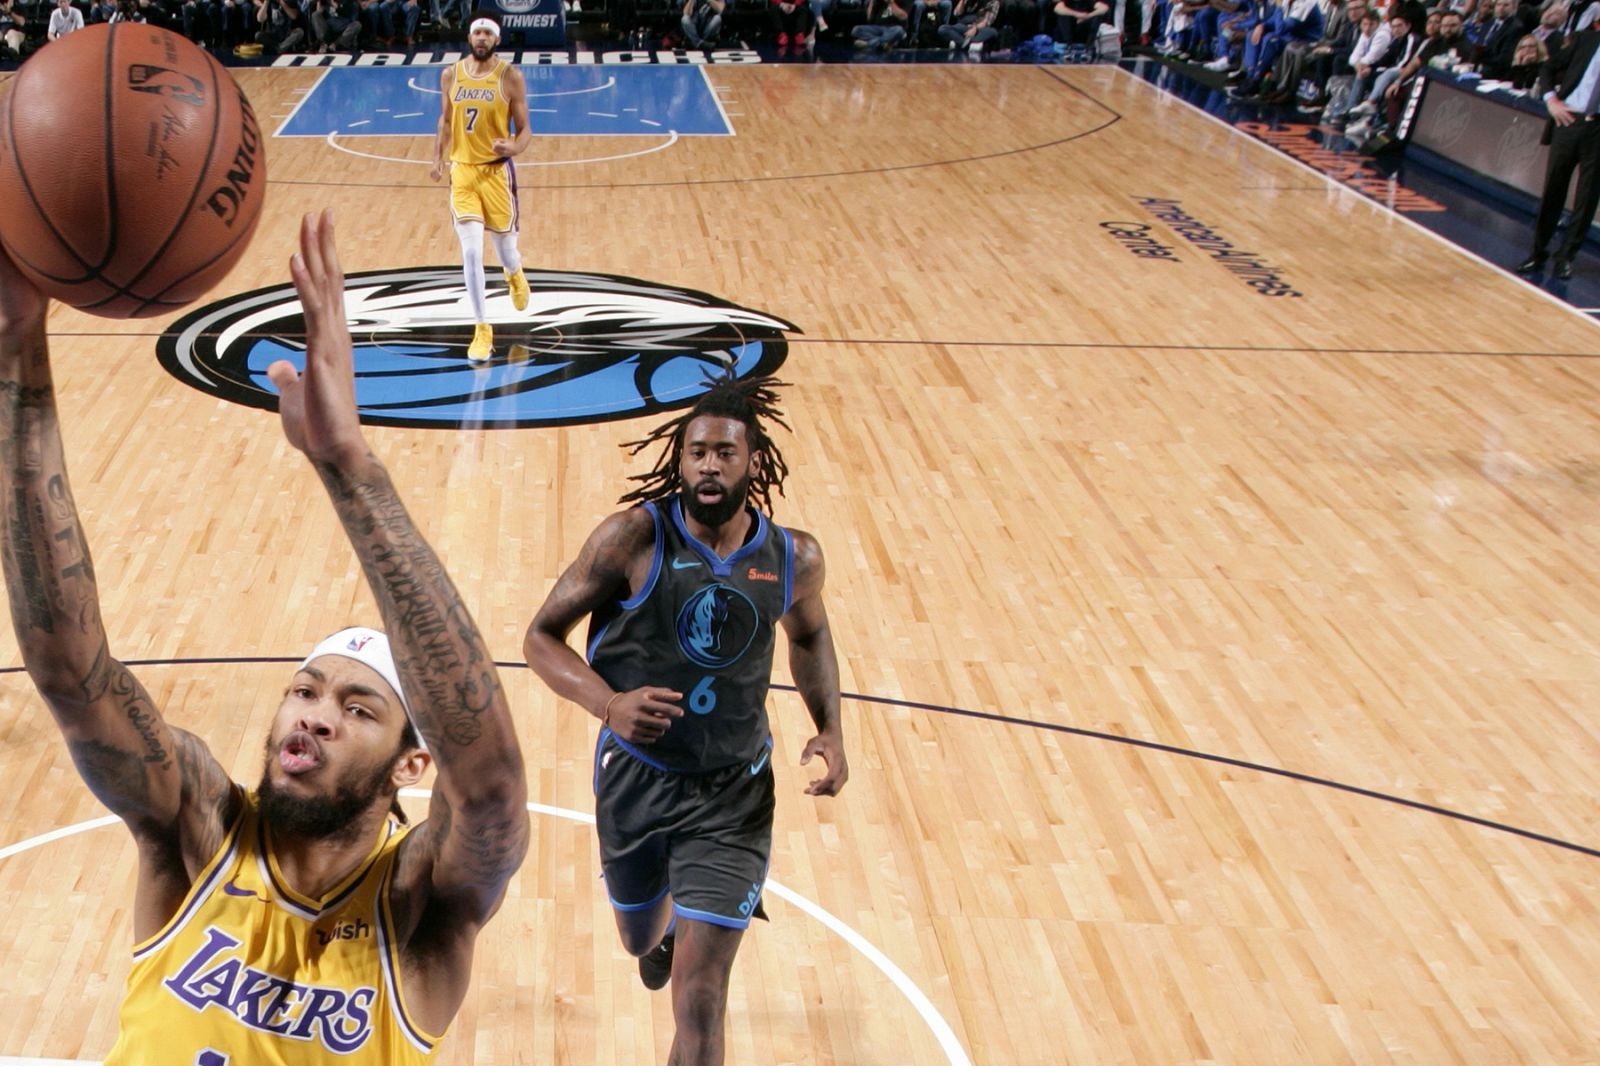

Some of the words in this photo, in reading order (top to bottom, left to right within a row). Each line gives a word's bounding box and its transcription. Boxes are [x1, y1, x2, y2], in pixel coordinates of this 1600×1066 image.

[502, 14, 557, 28] THWEST
[453, 86, 496, 102] LAKERS
[465, 107, 479, 132] 7
[1099, 221, 1183, 262] Center
[689, 676, 717, 715] 6
[316, 918, 370, 945] wish
[163, 926, 379, 1054] LAKERS
